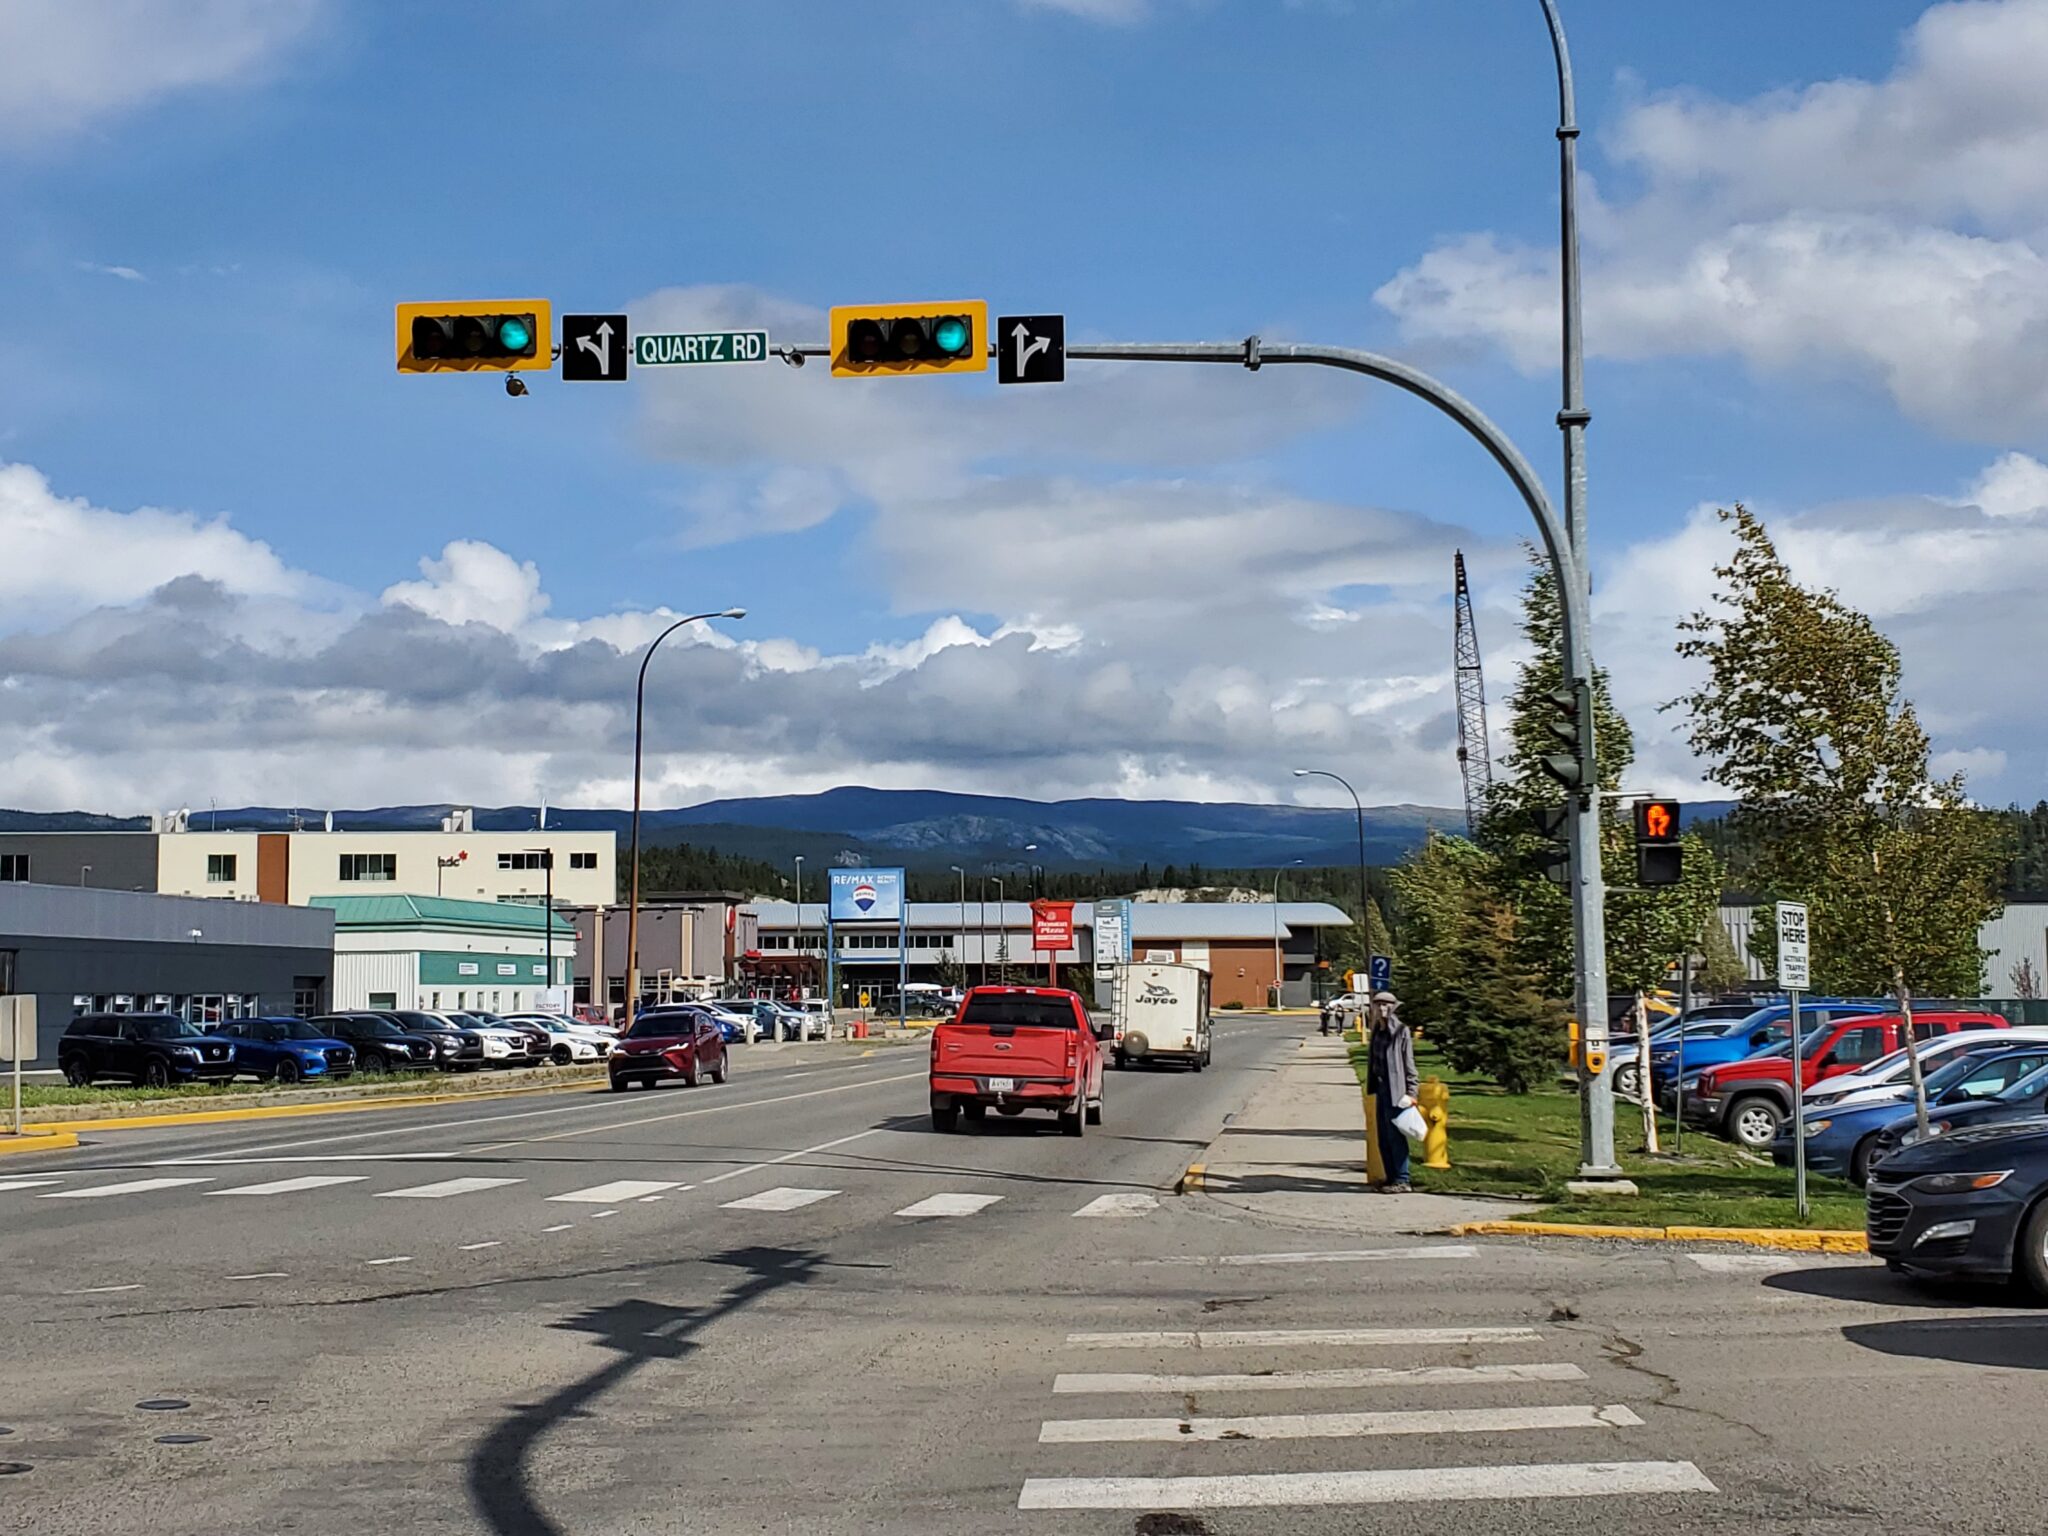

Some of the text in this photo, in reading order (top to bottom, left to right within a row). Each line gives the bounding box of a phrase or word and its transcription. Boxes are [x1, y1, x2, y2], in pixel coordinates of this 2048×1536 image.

[641, 334, 761, 362] QUARTZ RD
[833, 875, 873, 885] RE/MAX
[1781, 911, 1805, 927] STOP
[1782, 927, 1806, 944] HERE
[1791, 946, 1799, 954] TO
[1785, 964, 1806, 973] TRAFFIC
[1135, 994, 1178, 1006] Jayco
